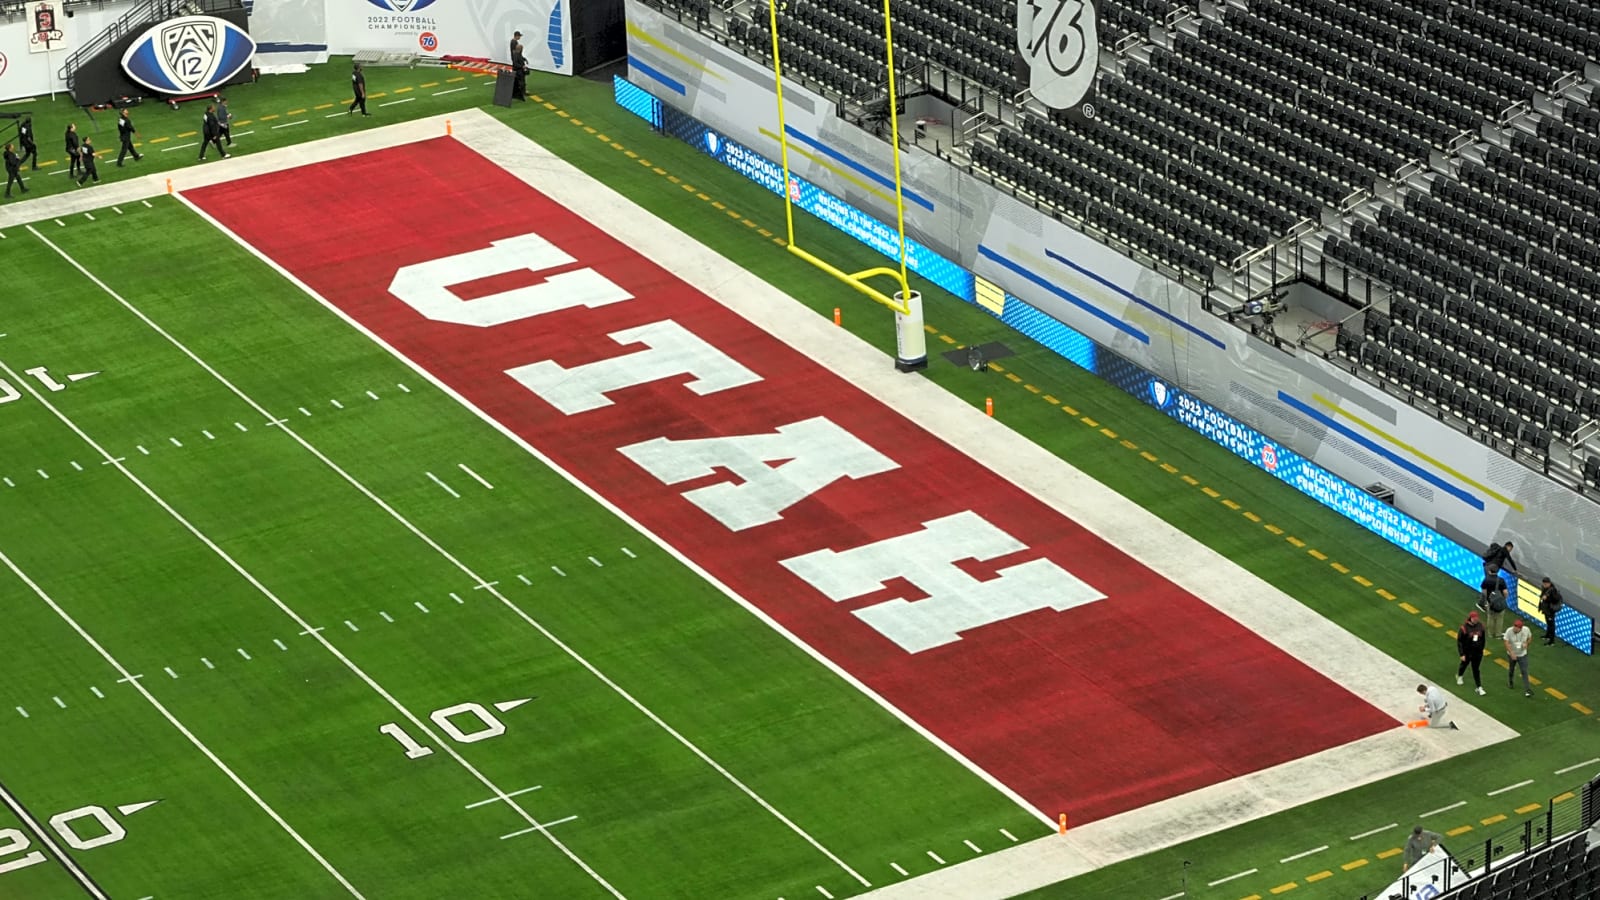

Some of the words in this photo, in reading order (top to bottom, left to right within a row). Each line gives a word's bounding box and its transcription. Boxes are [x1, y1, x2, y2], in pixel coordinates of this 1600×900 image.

[163, 24, 214, 64] PAC
[391, 16, 436, 25] FOOTBALL
[182, 57, 202, 76] 12
[387, 231, 1108, 655] UTAH
[1178, 395, 1202, 417] 2022
[1203, 408, 1255, 447] FOOTBALL
[1178, 409, 1254, 457] CHAMPIONSHIP
[1296, 475, 1339, 507] FOOTBALL
[1342, 500, 1411, 545] CHAMPIONSHIP
[1413, 540, 1439, 563] GAME
[1302, 463, 1343, 495] WELCOME
[1345, 488, 1357, 502] TO
[1359, 495, 1375, 513] THE
[1377, 506, 1399, 526] 2022
[1401, 519, 1433, 546] PAC-12
[379, 702, 507, 760] 10
